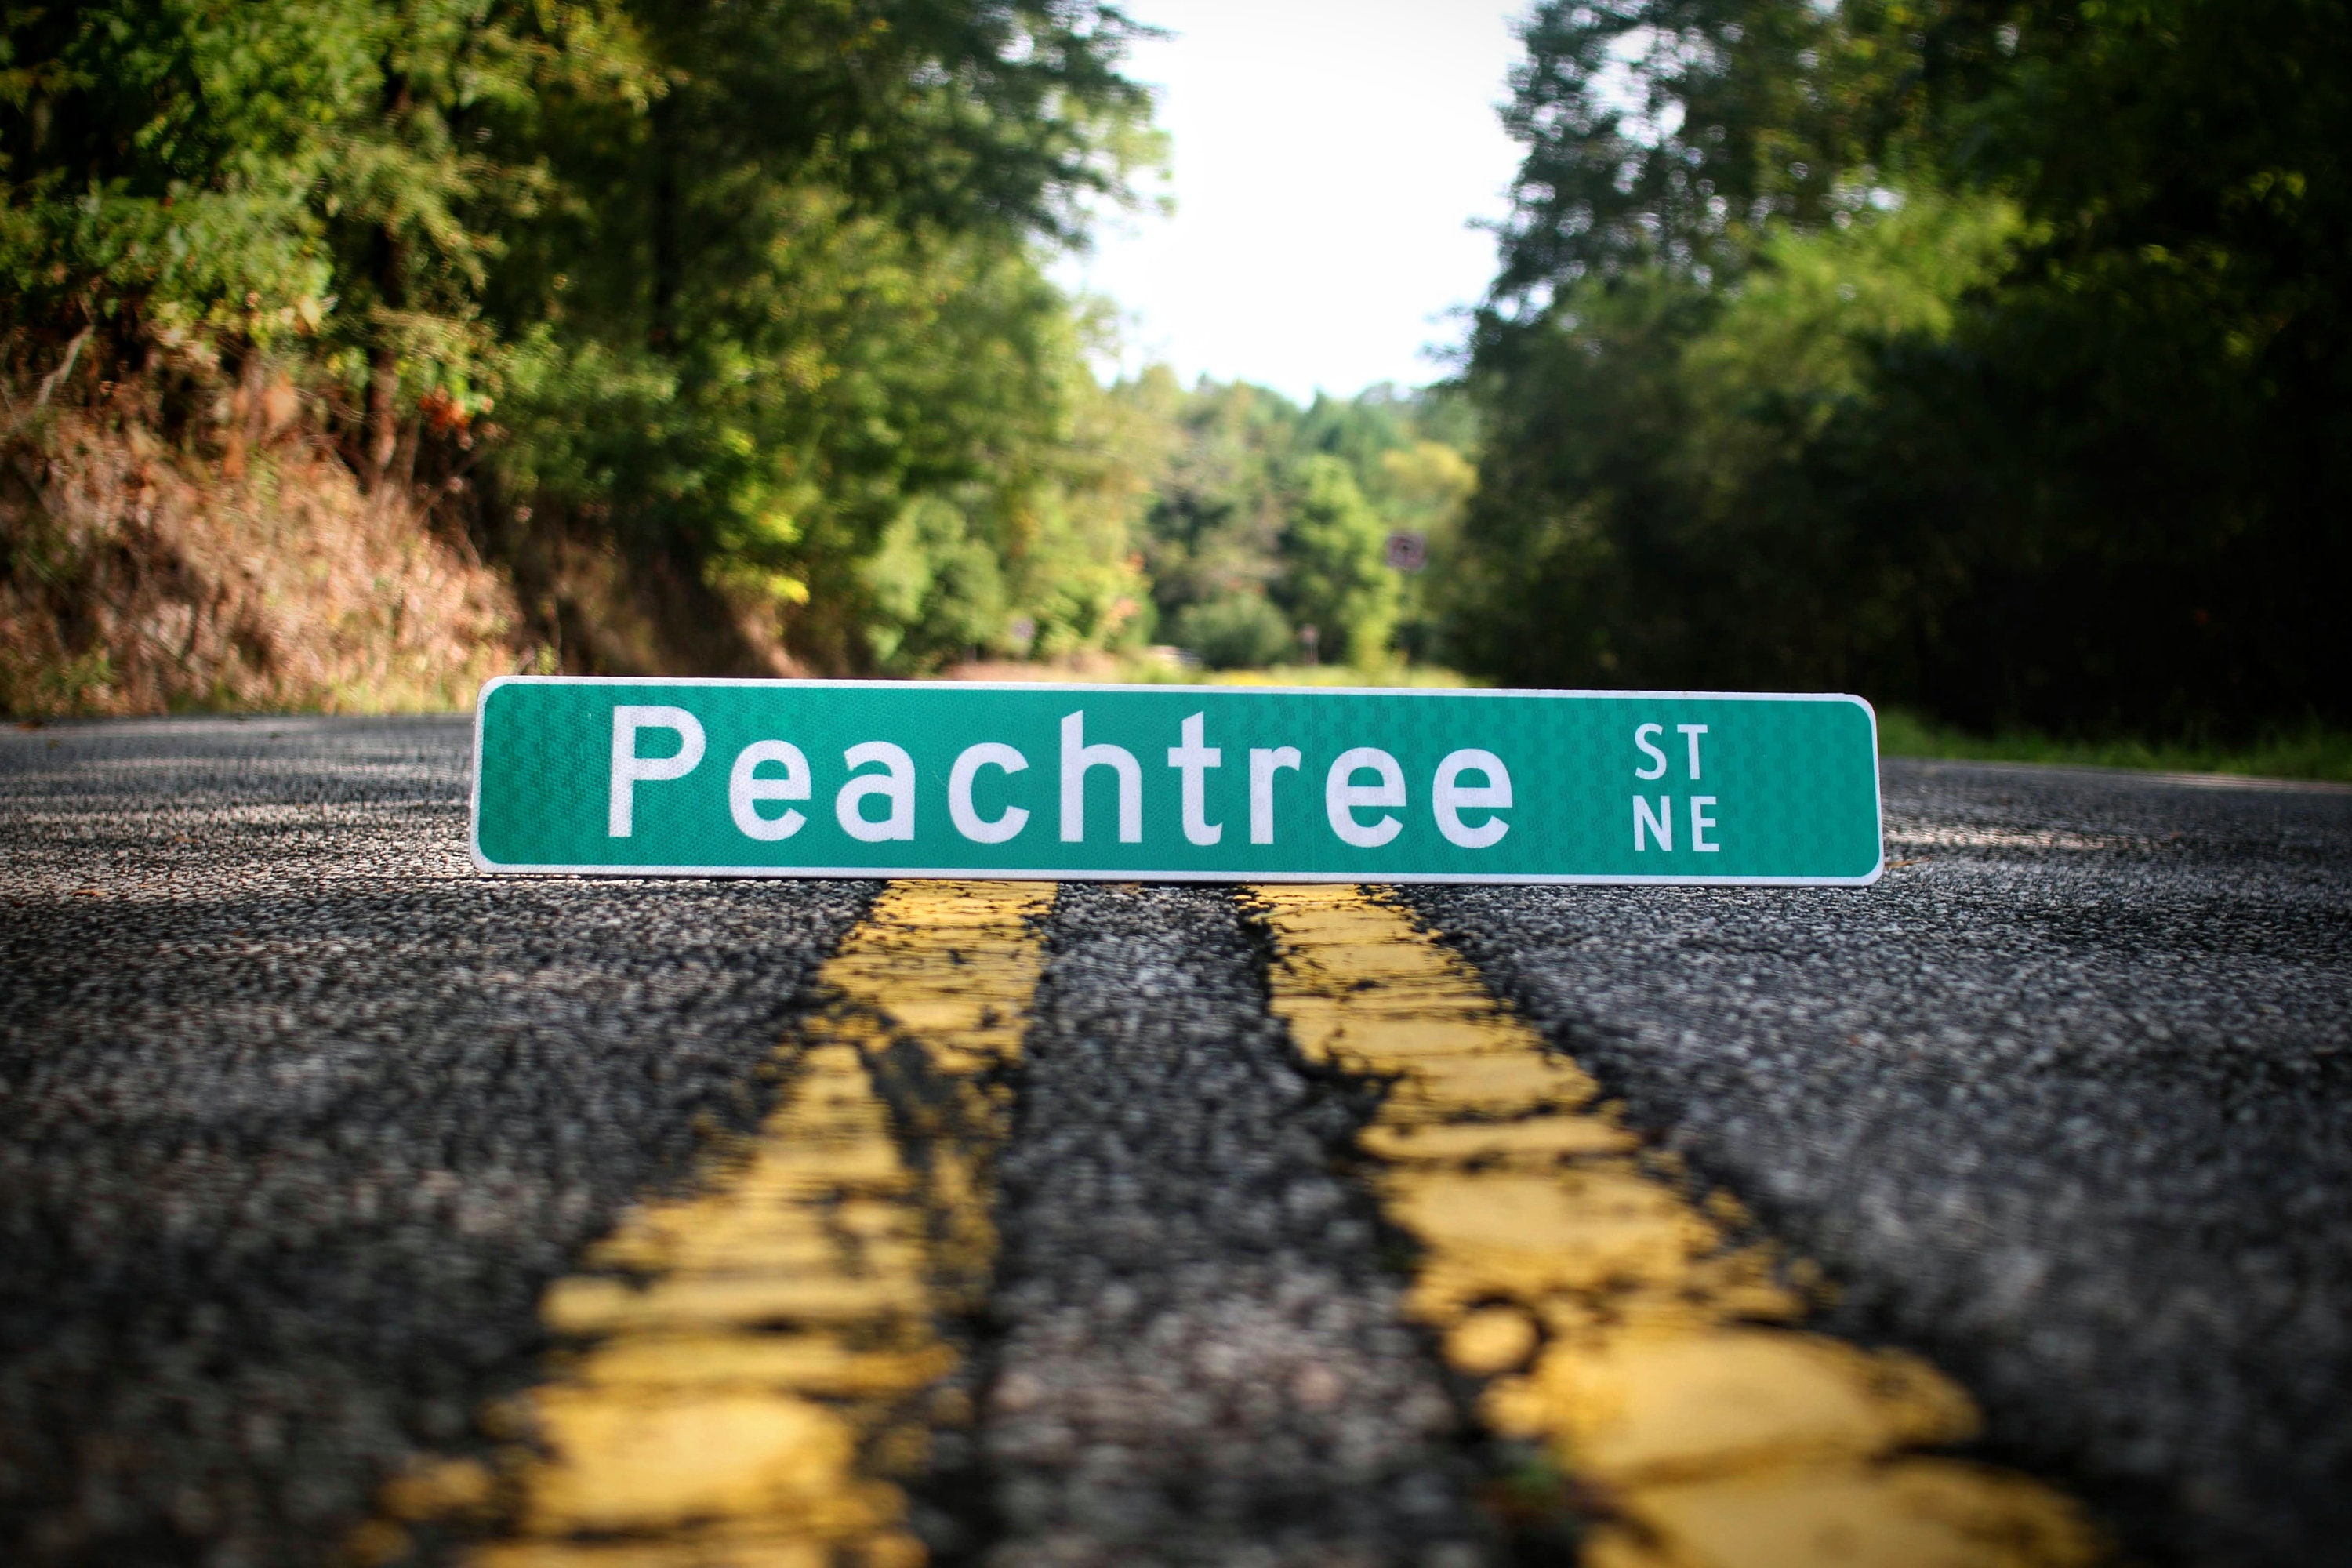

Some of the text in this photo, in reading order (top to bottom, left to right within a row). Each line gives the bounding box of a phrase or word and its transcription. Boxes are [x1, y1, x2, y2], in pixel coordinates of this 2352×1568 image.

[608, 704, 1513, 848] Peachtree
[1634, 723, 1708, 781] ST
[1633, 796, 1719, 853] NE
